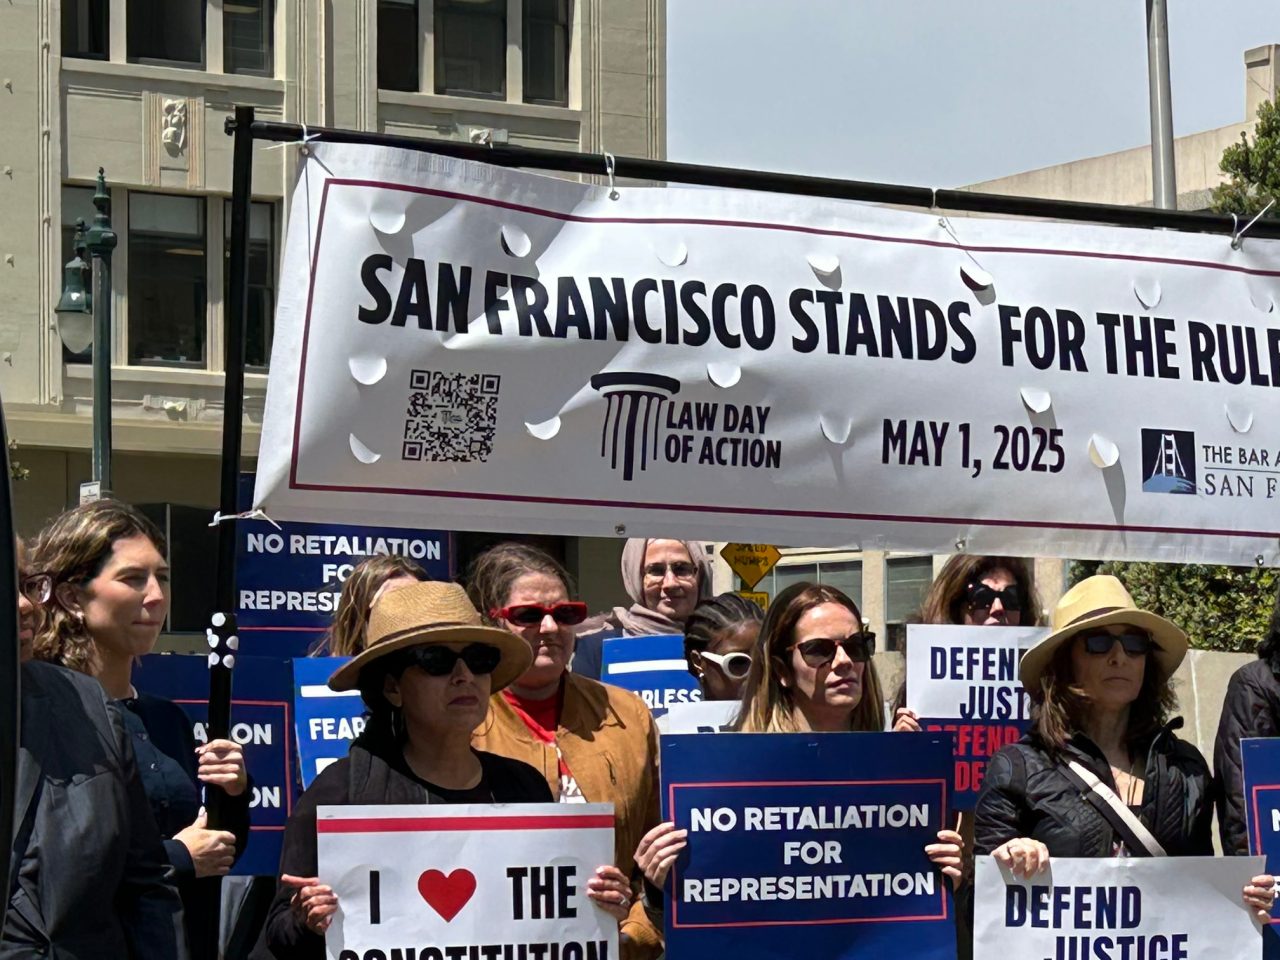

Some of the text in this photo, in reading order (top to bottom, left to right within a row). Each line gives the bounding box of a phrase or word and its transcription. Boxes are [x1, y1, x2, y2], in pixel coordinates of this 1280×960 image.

[358, 254, 472, 334] SAN
[484, 270, 776, 350] FRANCISCO
[789, 288, 977, 364] STANDS
[998, 304, 1088, 372] FOR
[1096, 312, 1180, 379] THE
[666, 401, 771, 434] LAW DAY
[665, 435, 782, 468] OF ACTION
[881, 418, 1066, 478] MAY 1, 2025
[1202, 445, 1232, 465] THE
[1239, 447, 1269, 467] BAR
[1204, 473, 1253, 498] SAN
[247, 533, 441, 560] NO RETALIATION
[690, 804, 929, 832] NO RETALIATION
[784, 841, 842, 865] FOR
[370, 865, 578, 925] I THE
[683, 871, 936, 903] REPRESENTATION
[1005, 884, 1141, 929] DEFEND
